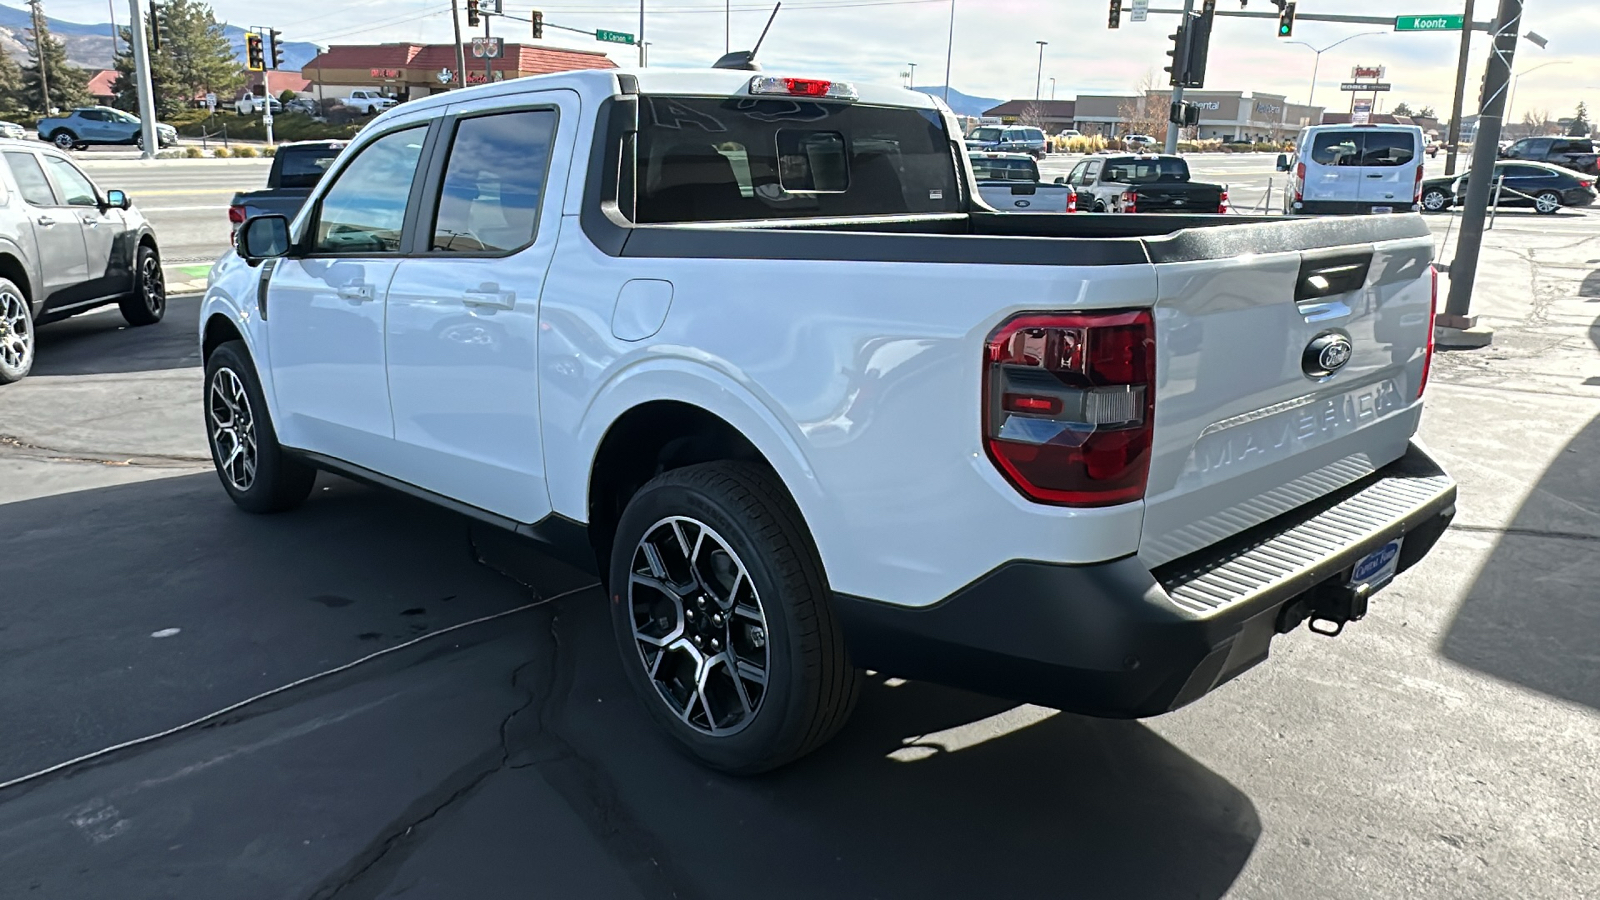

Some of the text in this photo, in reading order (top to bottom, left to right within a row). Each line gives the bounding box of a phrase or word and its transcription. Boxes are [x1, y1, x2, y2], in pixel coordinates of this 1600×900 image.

[1413, 17, 1447, 29] Koontz
[603, 32, 608, 40] S
[1191, 101, 1220, 111] Dental
[1202, 381, 1395, 473] MAVERICK
